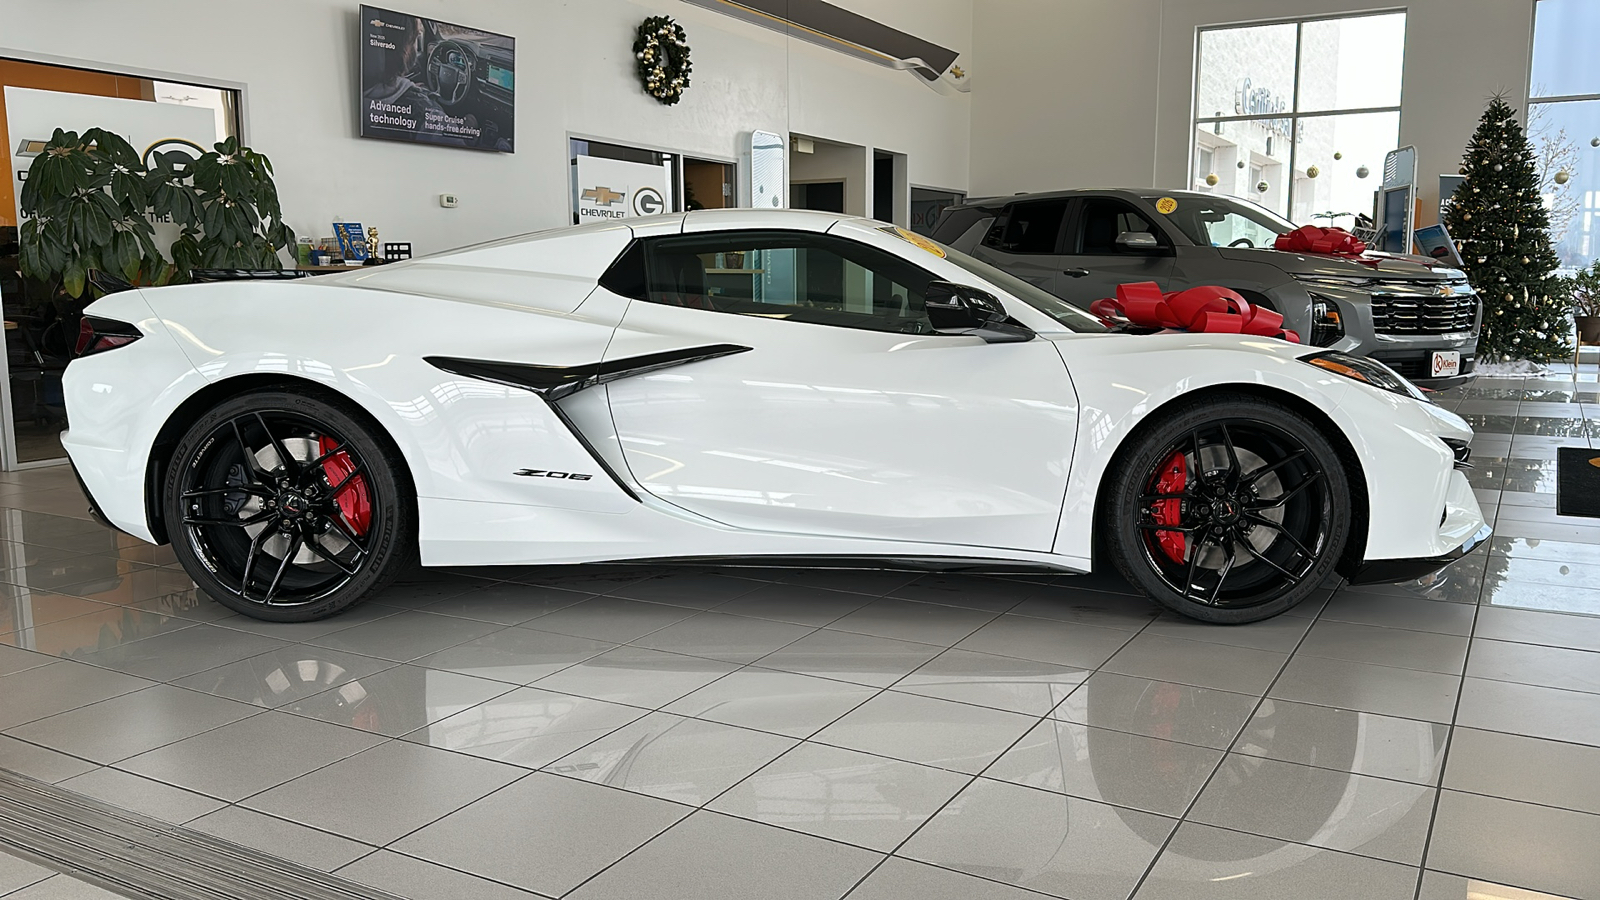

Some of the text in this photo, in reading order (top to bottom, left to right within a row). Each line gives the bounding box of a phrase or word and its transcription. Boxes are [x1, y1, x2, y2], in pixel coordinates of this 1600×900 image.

[369, 39, 396, 50] Silverado
[370, 100, 412, 115] Advanced
[370, 113, 417, 129] technology
[425, 112, 443, 122] Super
[425, 121, 460, 133] hands-free
[459, 126, 481, 137] driving
[580, 208, 625, 219] CHEVROLET
[512, 468, 593, 481] Z06
[371, 520, 393, 572] MICHELIN
